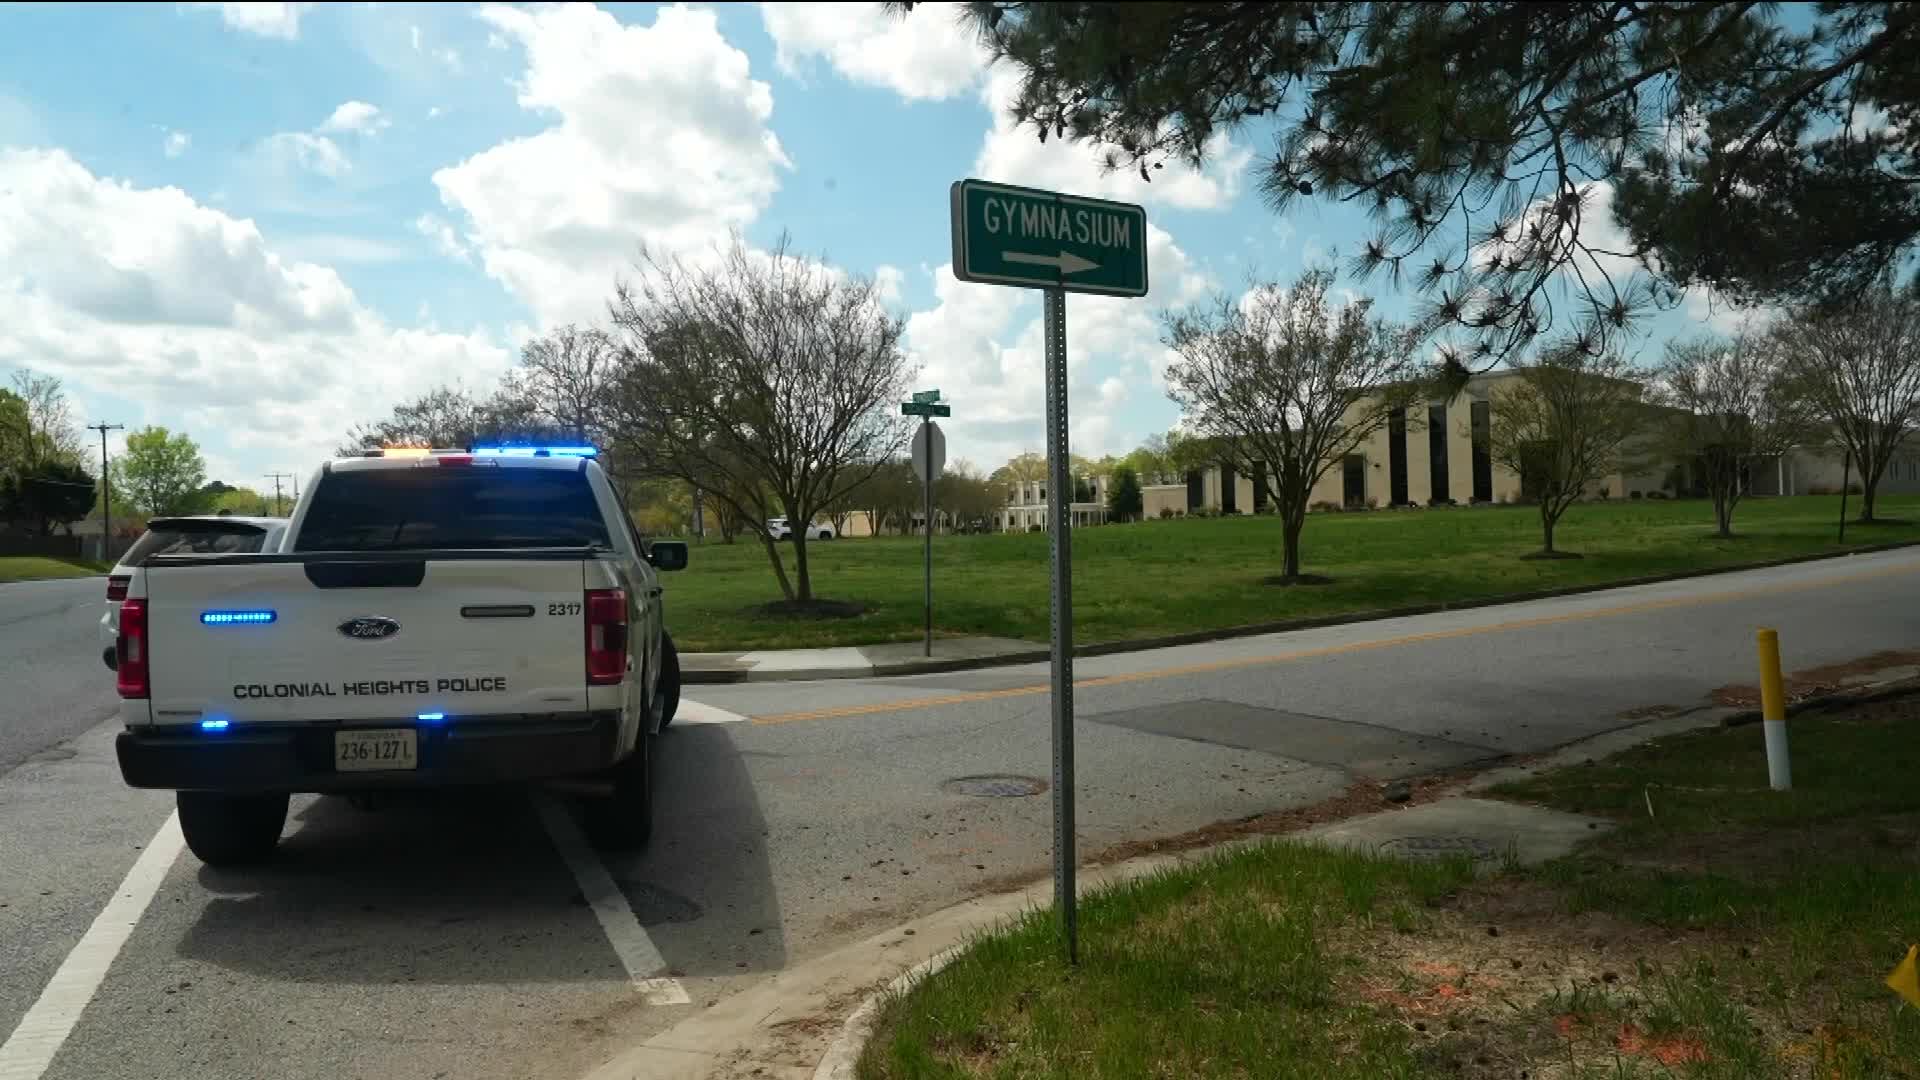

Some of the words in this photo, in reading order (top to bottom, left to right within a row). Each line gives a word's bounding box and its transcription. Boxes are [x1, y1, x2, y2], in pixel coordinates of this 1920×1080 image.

[983, 197, 1131, 249] GYMNASIUM
[548, 603, 582, 616] 2317
[351, 623, 387, 637] Ford
[233, 682, 337, 699] COLONIAL
[343, 680, 430, 696] HEIGHTS
[437, 677, 506, 693] POLICE
